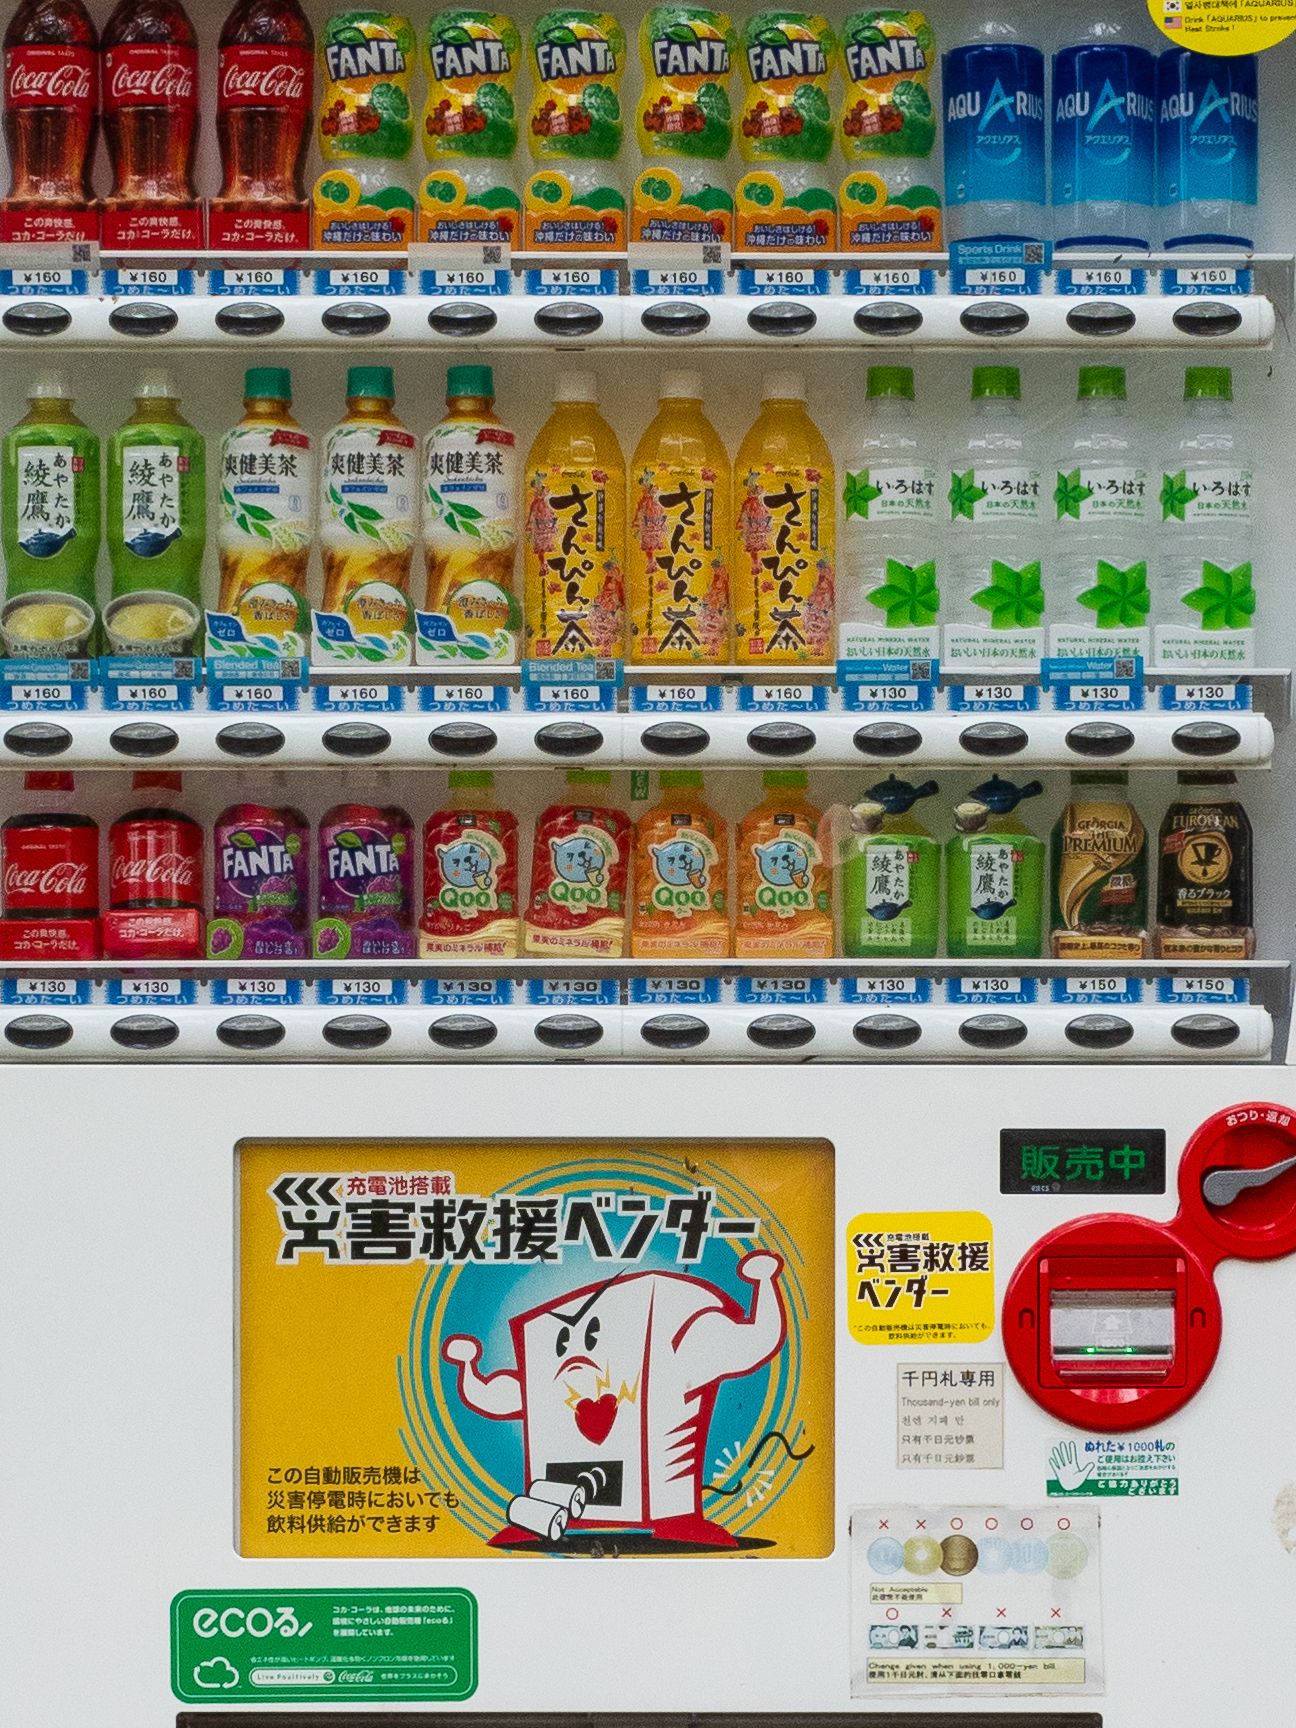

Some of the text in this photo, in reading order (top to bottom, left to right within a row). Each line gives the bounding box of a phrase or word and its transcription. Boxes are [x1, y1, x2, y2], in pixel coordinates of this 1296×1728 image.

[326, 40, 404, 79] FANTA
[431, 40, 510, 80] FANTA
[537, 40, 615, 80] FANTA
[654, 40, 729, 74] FANTA
[749, 40, 827, 81] FANTA
[846, 40, 925, 81] FANTA
[948, 78, 1043, 132] AQUARIUS
[1056, 78, 1154, 132] AQUARIUS
[1160, 78, 1258, 133] AQUARIUS
[24, 272, 61, 283] ¥160
[129, 272, 167, 283] ¥160
[235, 272, 273, 283] ¥160
[341, 272, 378, 283] ¥160
[447, 272, 484, 283] ¥160
[552, 272, 590, 283] ¥160
[660, 272, 697, 283] ¥160
[766, 272, 803, 283] ¥160
[874, 272, 910, 283] ¥160
[980, 272, 1016, 283] ¥160
[1086, 272, 1122, 283] ¥160
[1190, 272, 1226, 283] ¥160
[225, 452, 299, 477] 爽健美茶
[331, 452, 406, 478] 爽健美茶
[430, 450, 504, 476] 爽健美茶
[22, 458, 53, 521] 綾鷹
[54, 452, 71, 529] あやたか
[126, 458, 157, 521] 綾鷹
[159, 452, 176, 529] あやたか
[547, 484, 593, 655] さんぴん茶
[655, 482, 702, 653] さんぴん茶
[761, 483, 808, 654] さんぴん茶
[214, 660, 258, 671] Blended
[528, 662, 573, 673] Blended
[24, 688, 60, 699] ¥160
[130, 688, 167, 699] ¥160
[235, 688, 272, 699] ¥160
[341, 688, 378, 699] ¥160
[446, 688, 483, 699] ¥160
[552, 688, 589, 699] ¥160
[659, 688, 696, 699] ¥160
[765, 688, 802, 699] ¥160
[870, 688, 906, 699] ¥130
[975, 688, 1012, 699] ¥130
[1081, 688, 1118, 699] ¥130
[1187, 688, 1223, 699] ¥130
[1064, 835, 1138, 853] PREMIUM
[223, 845, 293, 878] FANTA
[328, 844, 400, 879] FANTA
[440, 887, 491, 908] Qoo
[551, 882, 601, 903] Qoo
[654, 886, 705, 907] Qoo
[758, 885, 809, 907] Qoo
[29, 981, 65, 992] ¥130
[133, 981, 168, 992] ¥130
[239, 981, 275, 992] ¥130
[343, 981, 380, 992] ¥130
[444, 981, 492, 992] ¥130
[549, 981, 598, 992] ¥130
[652, 981, 700, 992] ¥130
[756, 981, 805, 992] ¥130
[867, 981, 904, 992] ¥130
[972, 981, 1008, 992] ¥130
[1079, 981, 1117, 992] ¥150
[1186, 981, 1224, 992] ¥150
[1226, 1109, 1292, 1127] おつり・返却
[1021, 1144, 1147, 1181] 販売中
[347, 1175, 452, 1196] 充電池搭載
[272, 1177, 756, 1259] 災害救援ベンダー
[853, 1233, 989, 1273] 災害救援
[857, 1275, 949, 1308] ベンダー
[902, 1370, 995, 1387] 千円札専用
[902, 1397, 1000, 1408] Thousand-yen bill only
[267, 1466, 421, 1485] この自動販売機は
[267, 1490, 460, 1509] 災害停電時においても
[267, 1514, 440, 1533] 飲料供給ができます
[869, 1663, 900, 1671] Change
[905, 1663, 926, 1671] given
[959, 1663, 982, 1671] using
